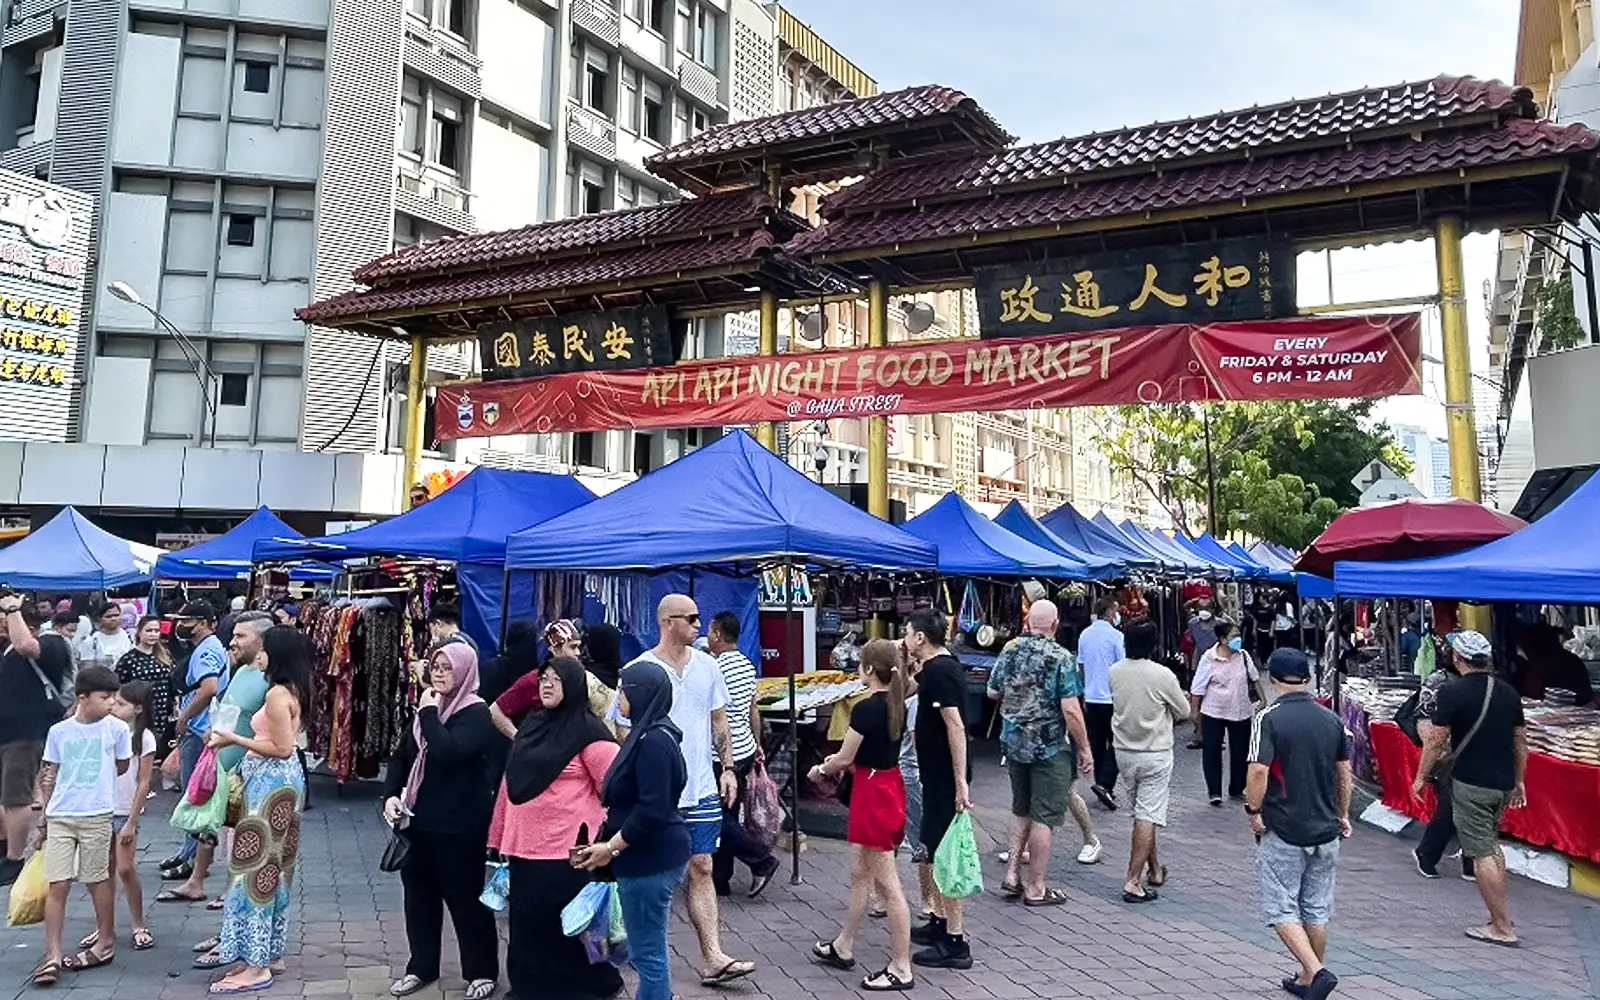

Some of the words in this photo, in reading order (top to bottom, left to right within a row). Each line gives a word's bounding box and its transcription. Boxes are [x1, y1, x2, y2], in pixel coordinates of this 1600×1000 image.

[999, 255, 1251, 323] 政通人和
[494, 321, 635, 368] 國泰民安
[1273, 337, 1328, 351] EVERY
[1219, 355, 1279, 369] FRIDAY
[1281, 354, 1293, 367] &
[1296, 350, 1388, 367] SATURDAY
[641, 371, 685, 407] API
[693, 366, 740, 404] API
[747, 356, 849, 396] NIGHT
[855, 351, 953, 393] FOOD
[964, 337, 1120, 387] MARKET
[1252, 372, 1263, 384] 6
[1266, 371, 1293, 383] PM
[1306, 370, 1322, 382] 12
[1325, 369, 1353, 382] AM
[787, 400, 802, 417] @
[806, 397, 845, 417] GAYA
[848, 393, 904, 413] STREET
